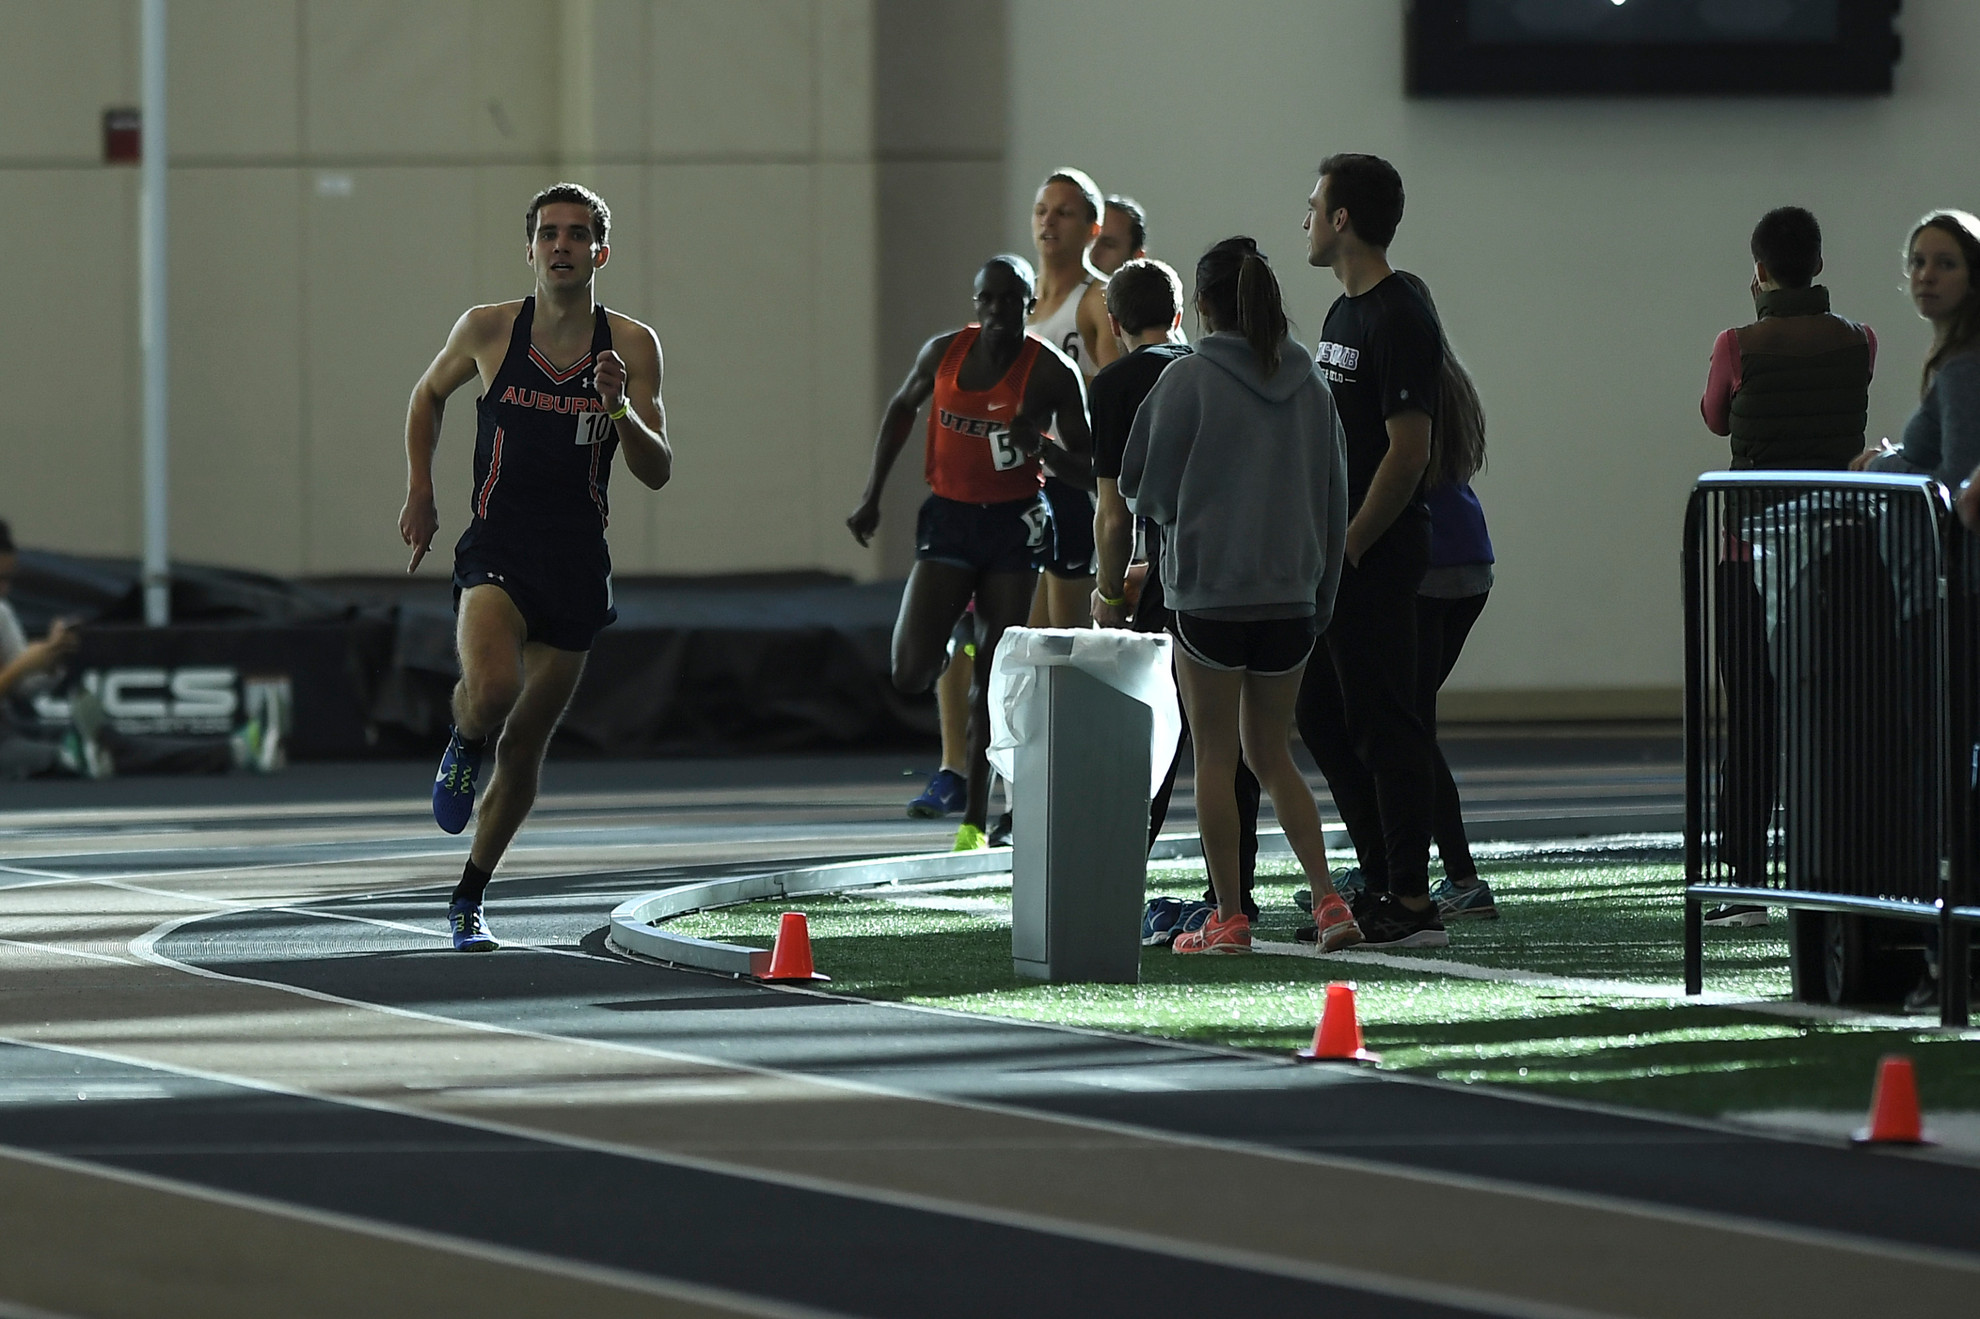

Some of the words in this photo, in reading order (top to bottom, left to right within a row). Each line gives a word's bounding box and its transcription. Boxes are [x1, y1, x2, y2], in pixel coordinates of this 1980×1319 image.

[1063, 332, 1079, 361] 6
[499, 386, 606, 415] AUBURN
[586, 413, 609, 443] 10
[997, 433, 1017, 467] 5
